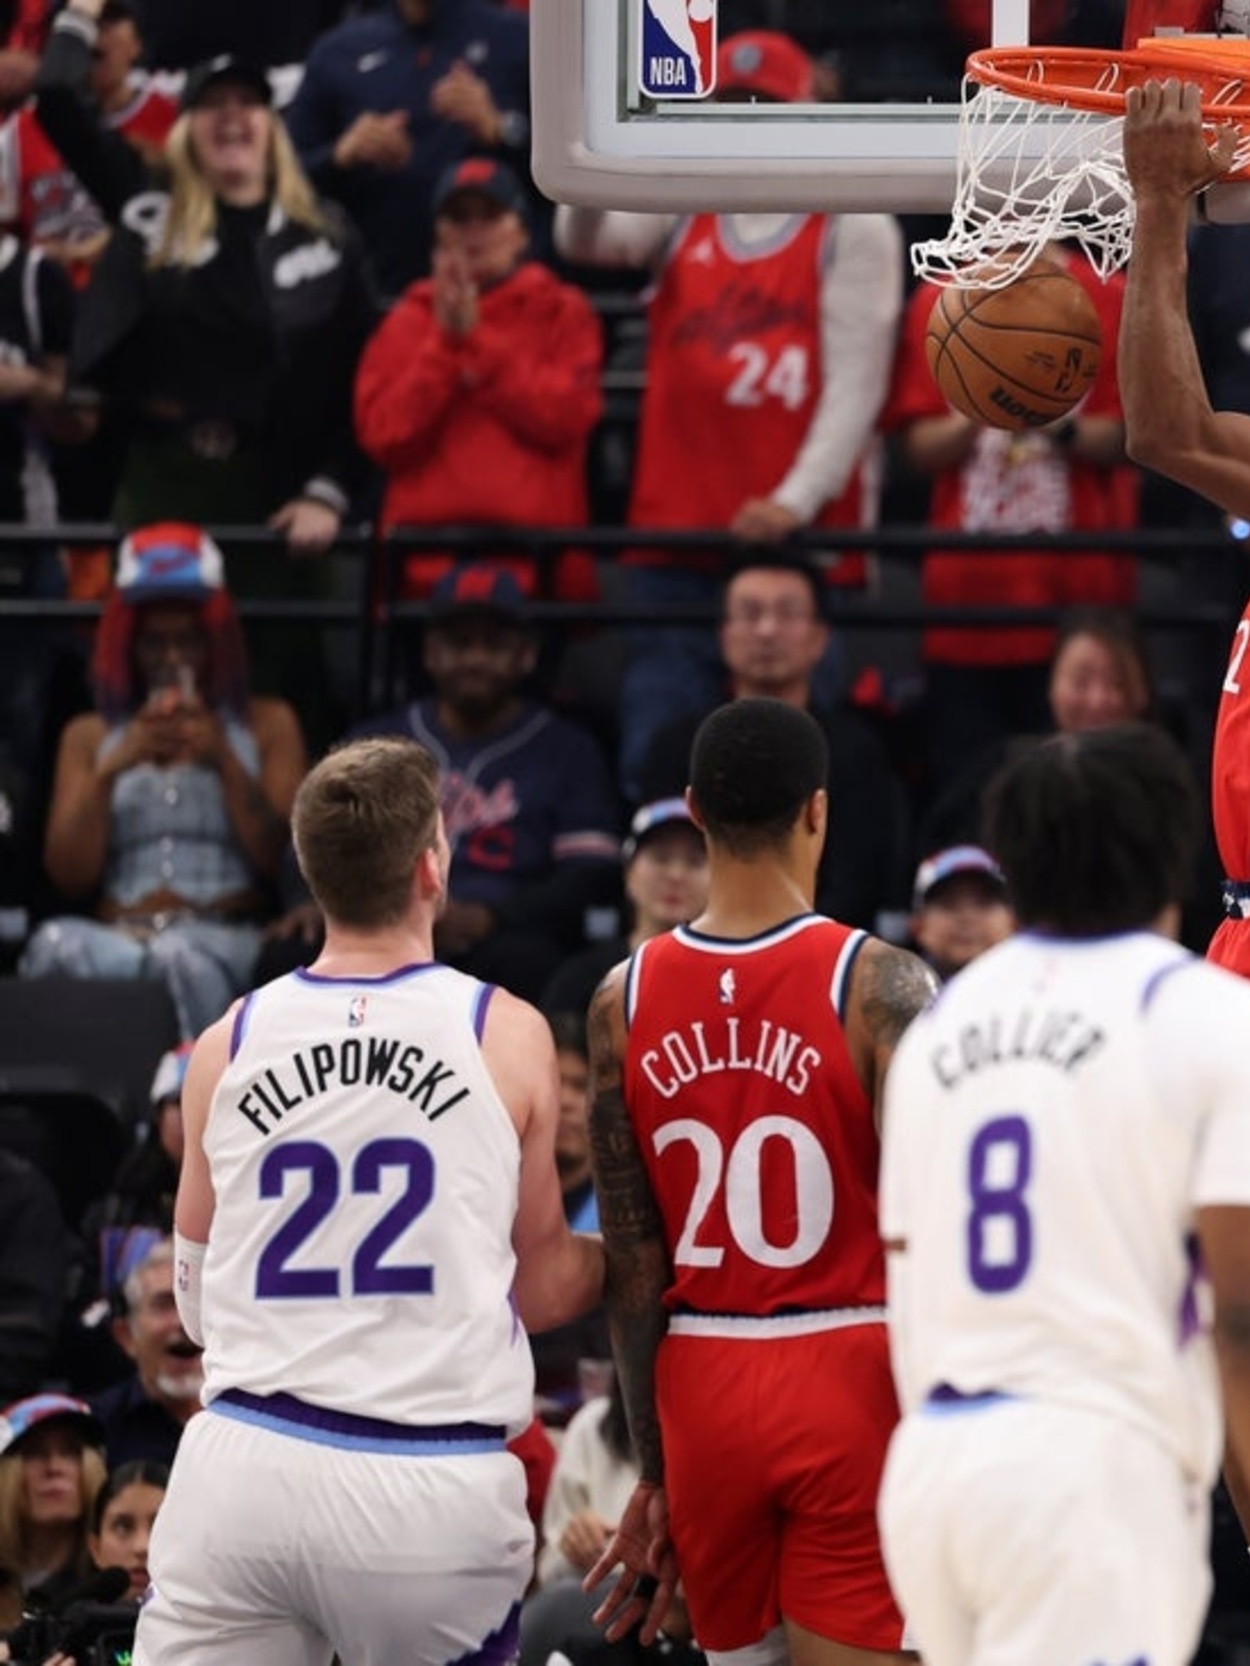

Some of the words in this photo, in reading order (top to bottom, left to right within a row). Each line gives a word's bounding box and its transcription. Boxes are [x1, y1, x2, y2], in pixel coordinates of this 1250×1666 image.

[650, 57, 687, 86] NBA
[724, 340, 810, 412] 24
[237, 1037, 471, 1136] FILIPOWSKI
[641, 1017, 822, 1098] COLLINS
[930, 1006, 1108, 1092] COLLIER
[255, 1137, 436, 1300] 22
[652, 1115, 835, 1269] 20
[966, 1115, 1034, 1294] 8
